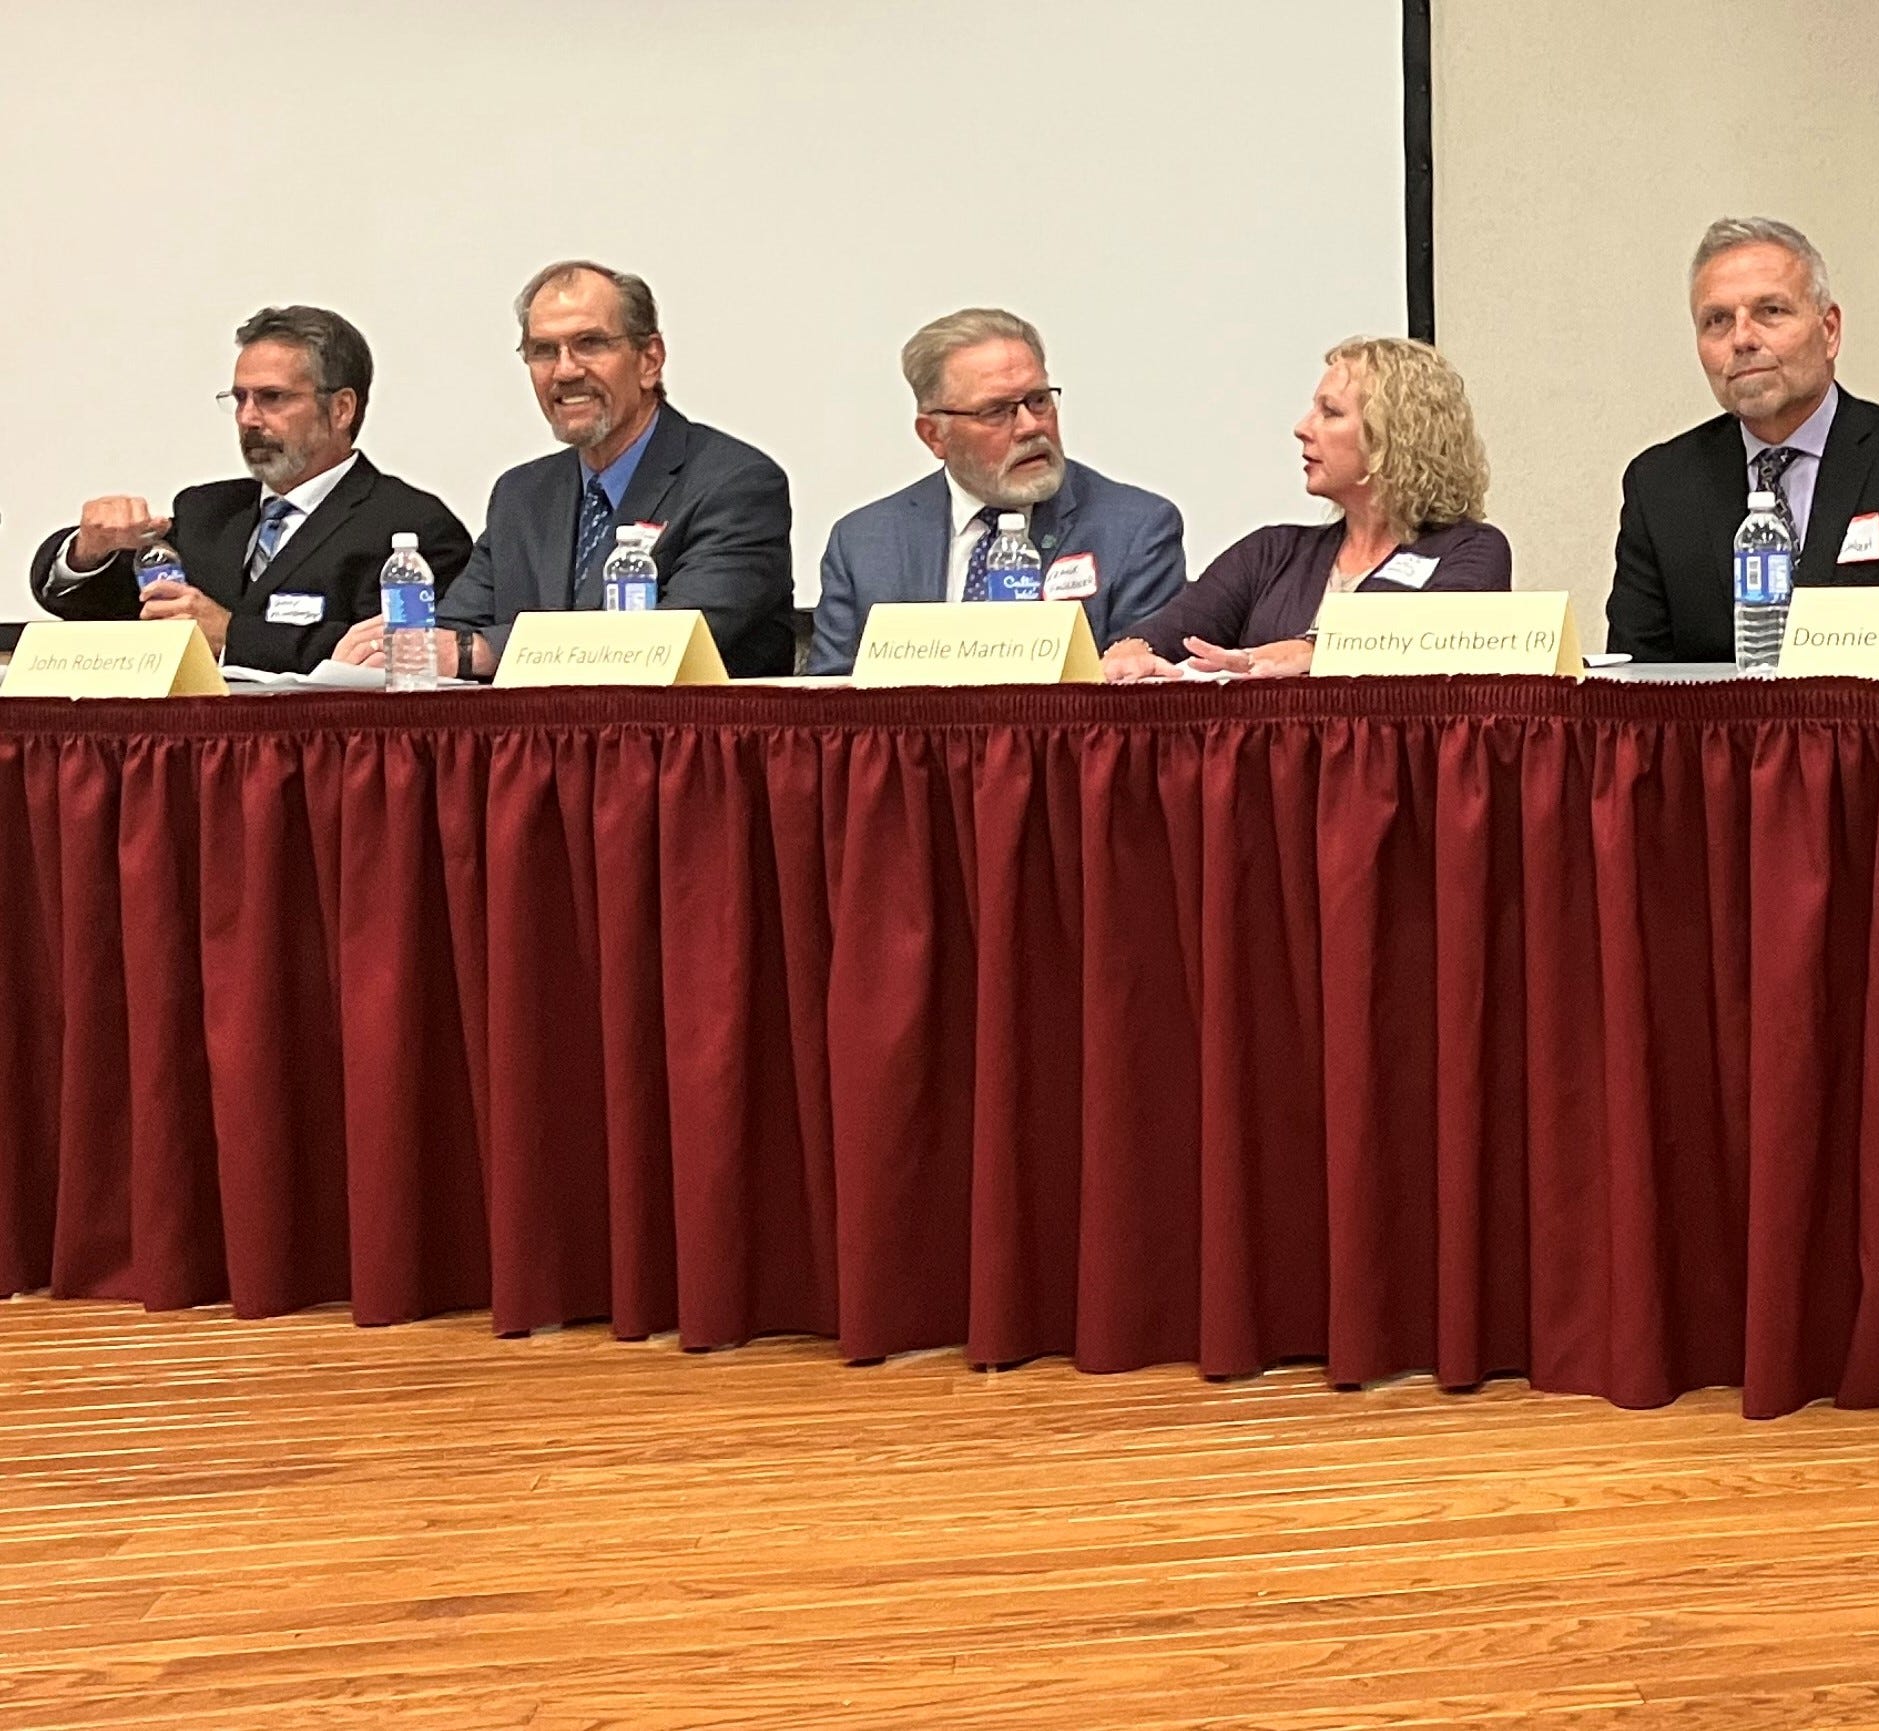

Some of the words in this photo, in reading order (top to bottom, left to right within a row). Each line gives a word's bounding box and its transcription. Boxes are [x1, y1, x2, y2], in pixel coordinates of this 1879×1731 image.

[1325, 631, 1414, 655] Timothy
[1419, 630, 1518, 651] Cuthbert
[1525, 629, 1556, 653] (R)
[1793, 626, 1878, 647] Donnie
[515, 645, 565, 665] Frank
[567, 644, 644, 664] Faulkner
[645, 644, 672, 668] (R)
[868, 639, 952, 660] Michelle
[957, 639, 1024, 659] Martin
[1030, 637, 1061, 662] (D)
[28, 653, 68, 672] John
[72, 652, 136, 672] Roberts
[137, 652, 163, 673] (R)
